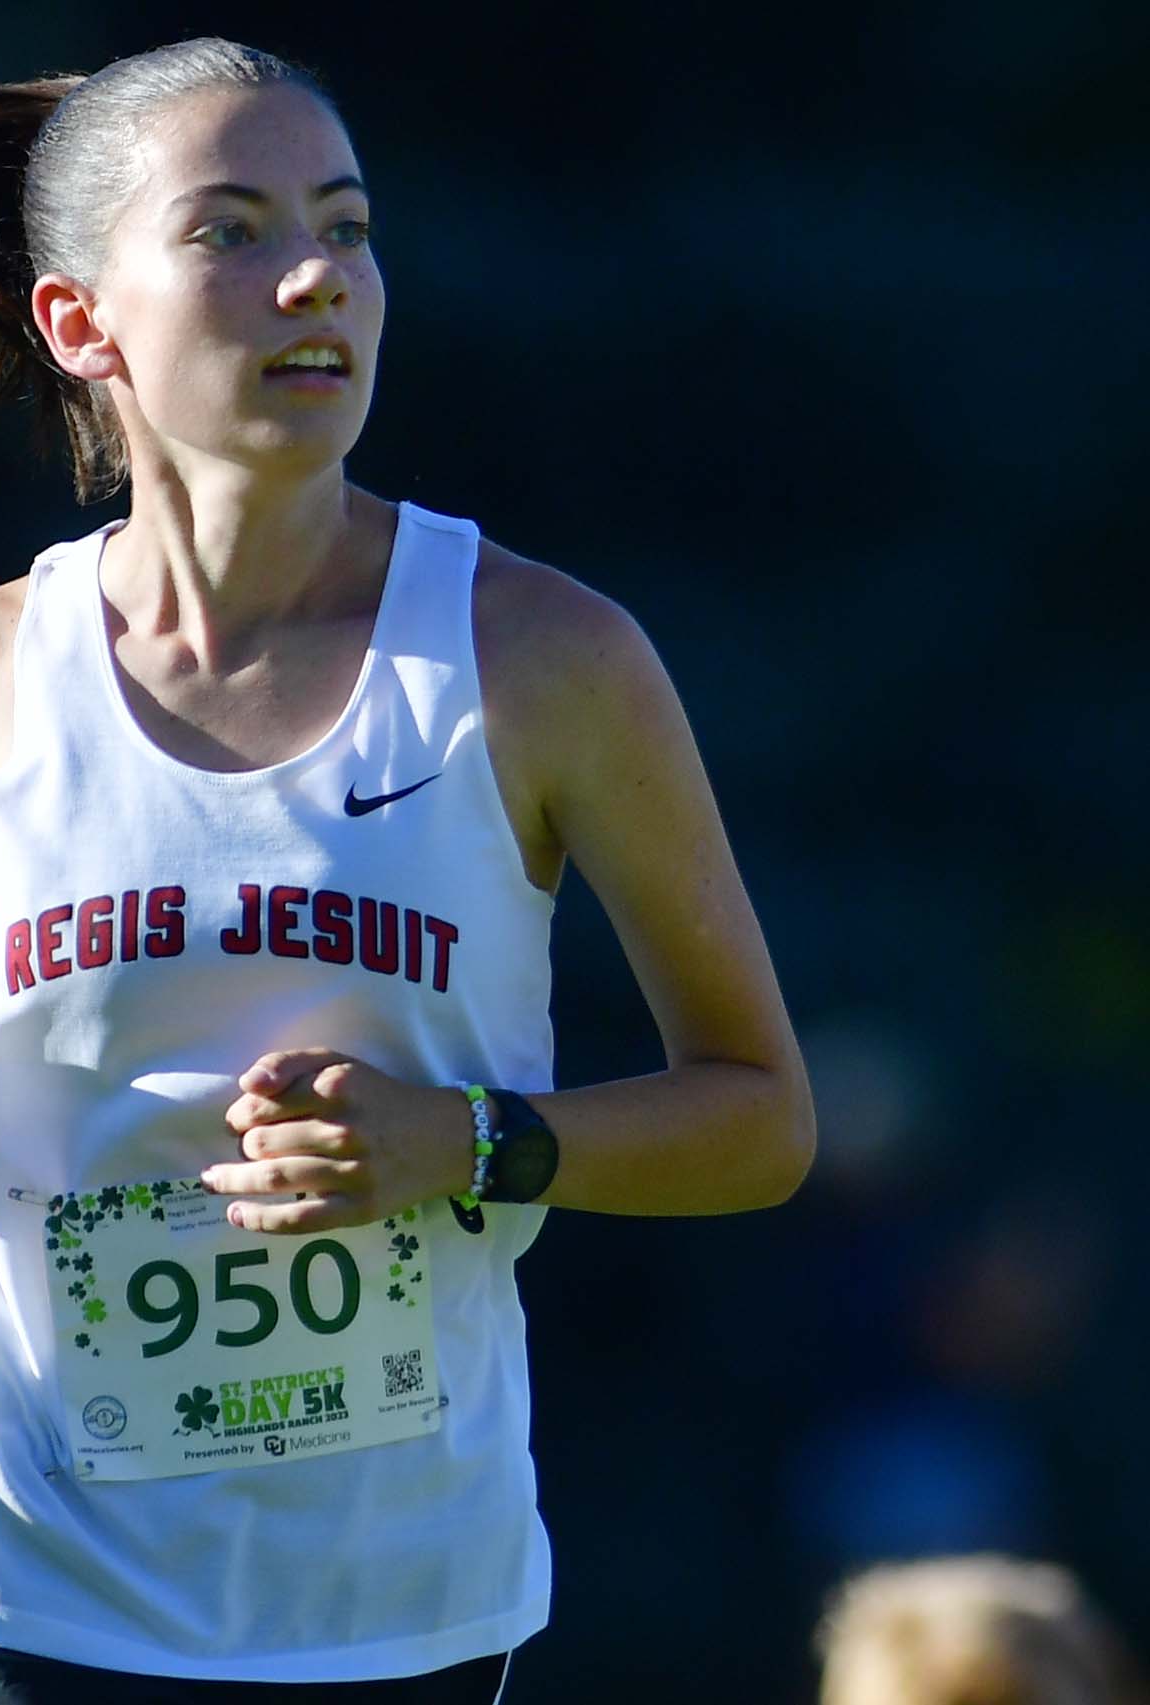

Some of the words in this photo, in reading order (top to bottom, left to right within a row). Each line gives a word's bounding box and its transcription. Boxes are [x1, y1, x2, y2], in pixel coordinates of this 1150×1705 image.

[5, 884, 186, 997] REGIS
[220, 883, 459, 993] JESUIT
[126, 1238, 361, 1359] 950
[219, 1381, 245, 1398] ST.
[250, 1365, 345, 1394] PATRICK'S
[221, 1391, 293, 1427] DAY
[302, 1382, 347, 1415] 5K
[224, 1421, 286, 1438] HIGHLANDS
[288, 1415, 323, 1429] RANCH
[325, 1410, 349, 1423] 2023
[290, 1430, 351, 1451] Medicine
[184, 1445, 238, 1460] Presented
[241, 1443, 255, 1455] by
